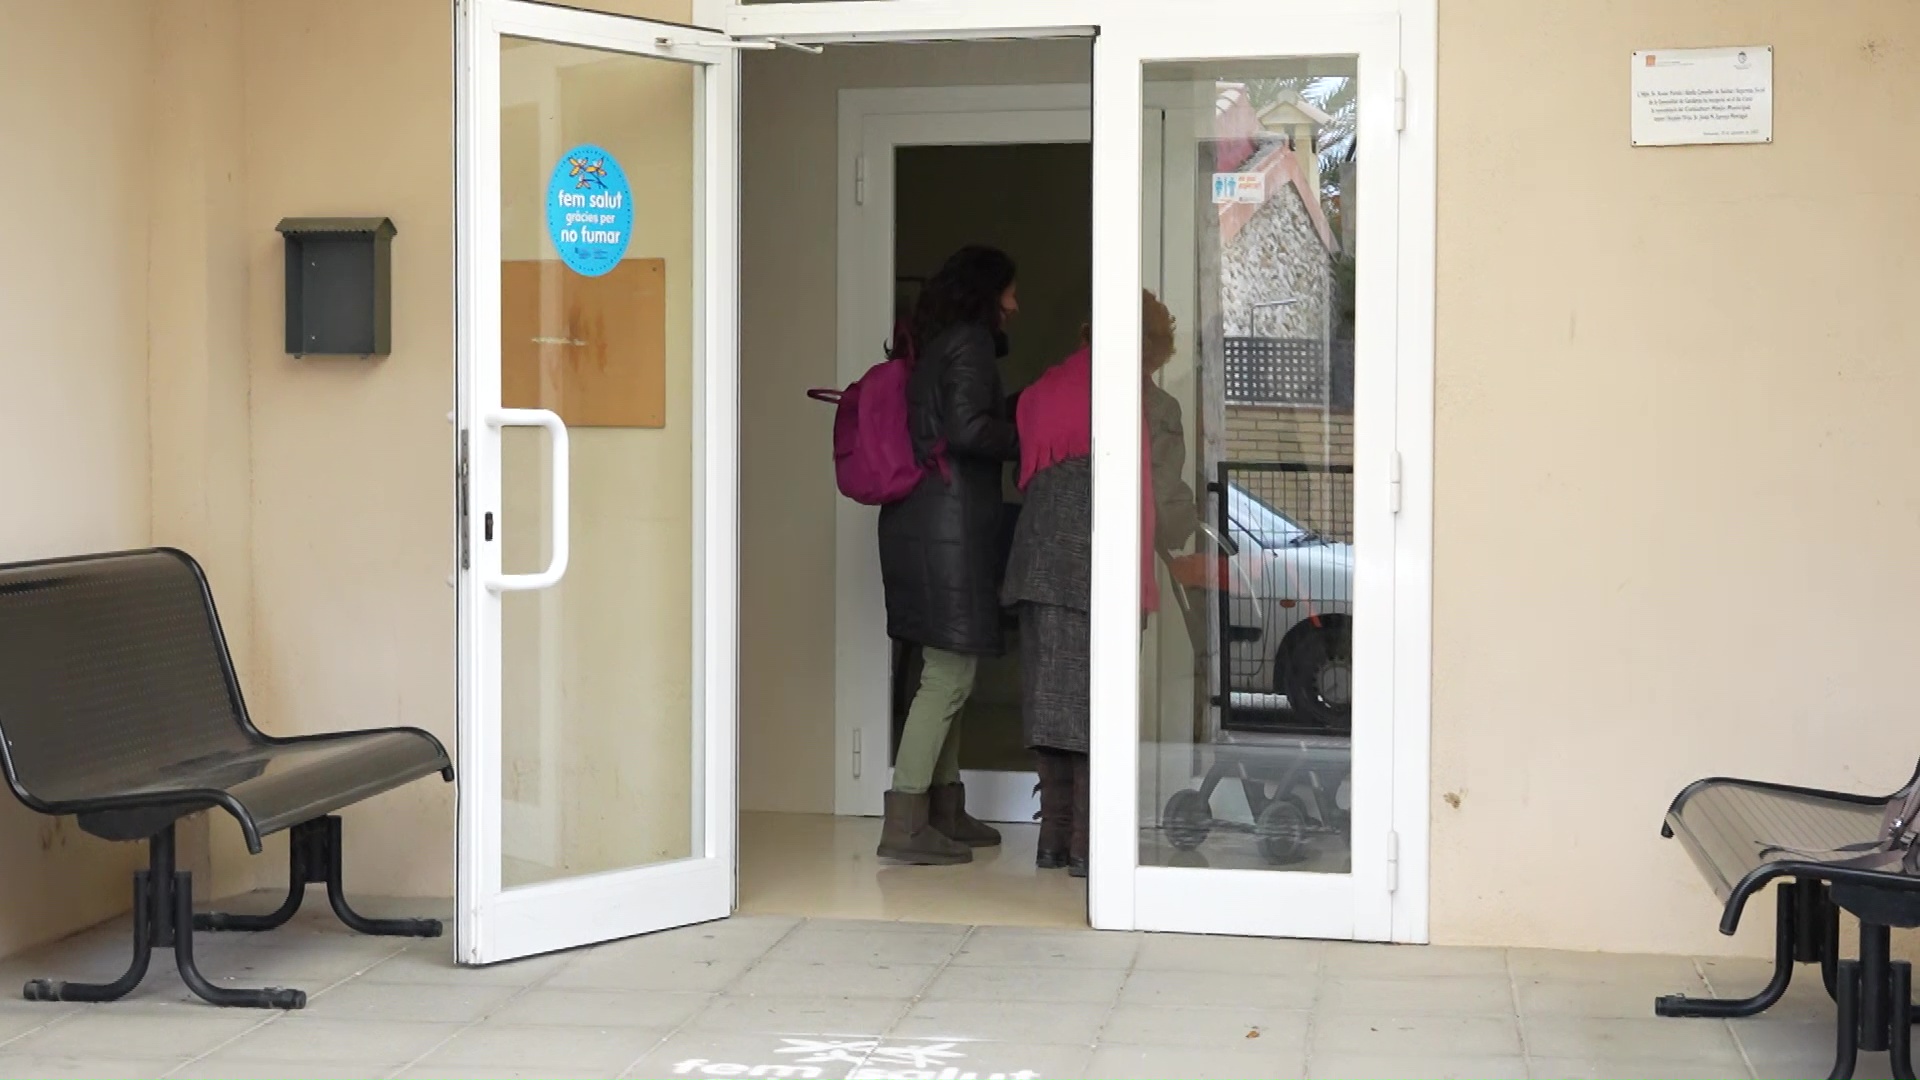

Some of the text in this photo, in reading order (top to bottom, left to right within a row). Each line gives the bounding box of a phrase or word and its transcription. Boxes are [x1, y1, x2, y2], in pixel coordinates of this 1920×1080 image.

[558, 189, 622, 209] fem salut
[600, 214, 615, 226] per
[561, 225, 621, 244] no fumar
[672, 1059, 822, 1078] fem
